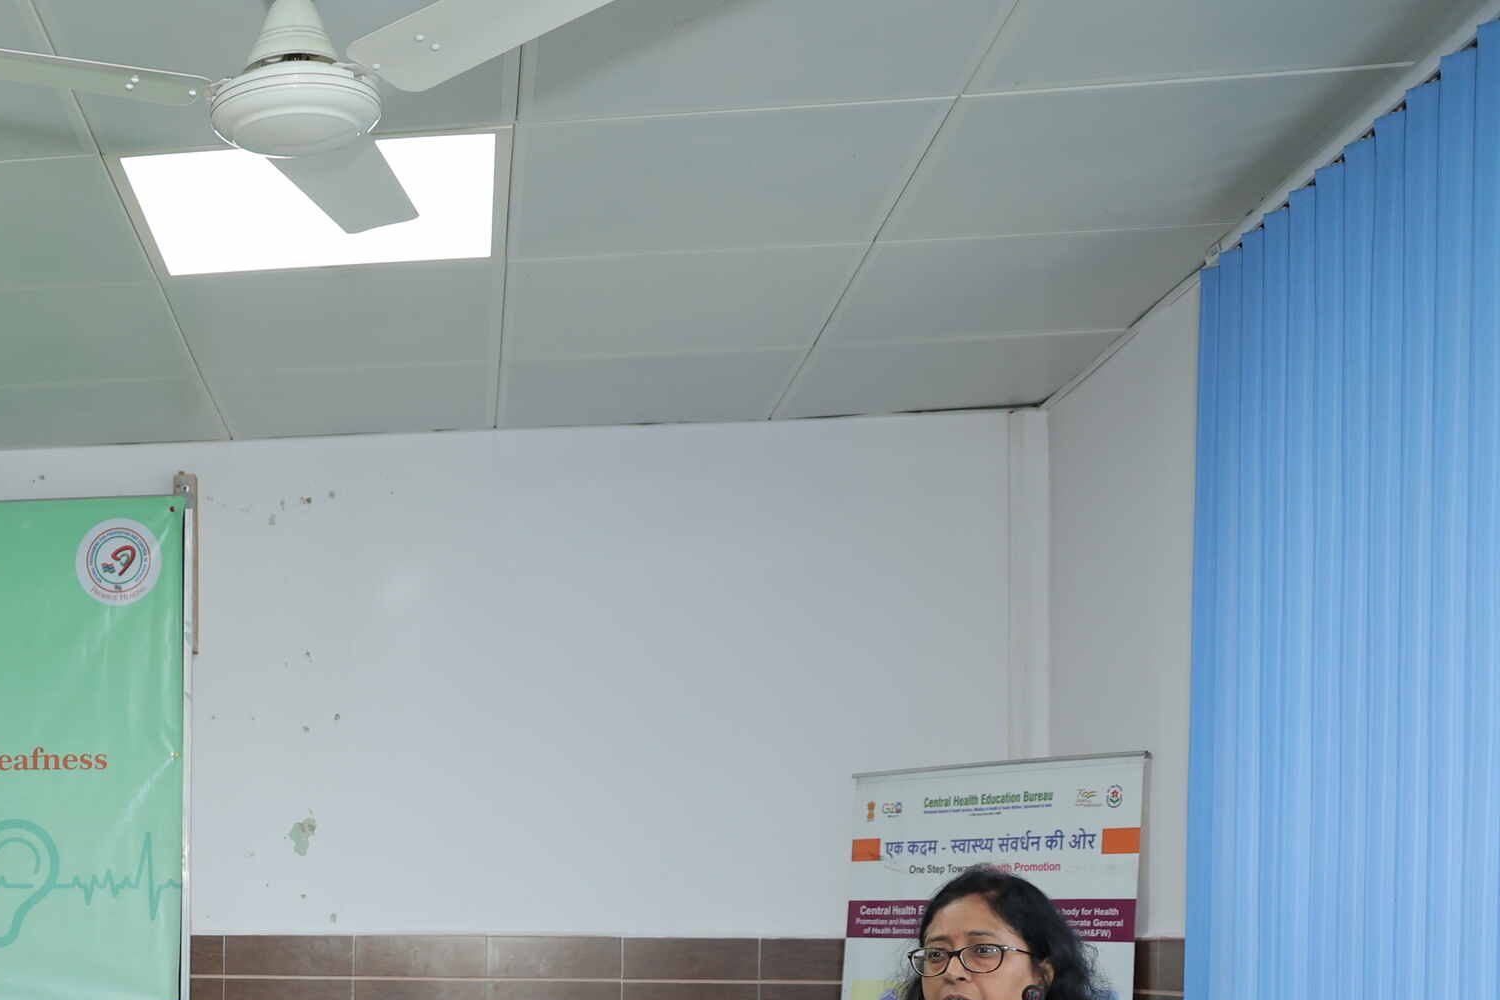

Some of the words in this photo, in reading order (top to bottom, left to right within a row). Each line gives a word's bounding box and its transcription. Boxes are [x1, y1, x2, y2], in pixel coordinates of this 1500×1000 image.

[923, 797, 952, 809] Central
[953, 795, 979, 807] Health
[980, 792, 1021, 805] Education
[1023, 790, 1054, 802] Bureau
[885, 841, 904, 858] एक
[907, 840, 939, 856] कदम
[950, 837, 995, 854] स्वास्थ्य
[998, 830, 1042, 852] संवर्धन
[1045, 829, 1065, 851] की
[1069, 828, 1097, 850] ओर
[909, 864, 925, 875] One
[927, 863, 945, 875] Step
[1013, 862, 1061, 872] Promotion
[860, 905, 891, 915] Central
[892, 905, 917, 915] Health
[1093, 907, 1119, 916] Health
[1092, 918, 1124, 927] General
